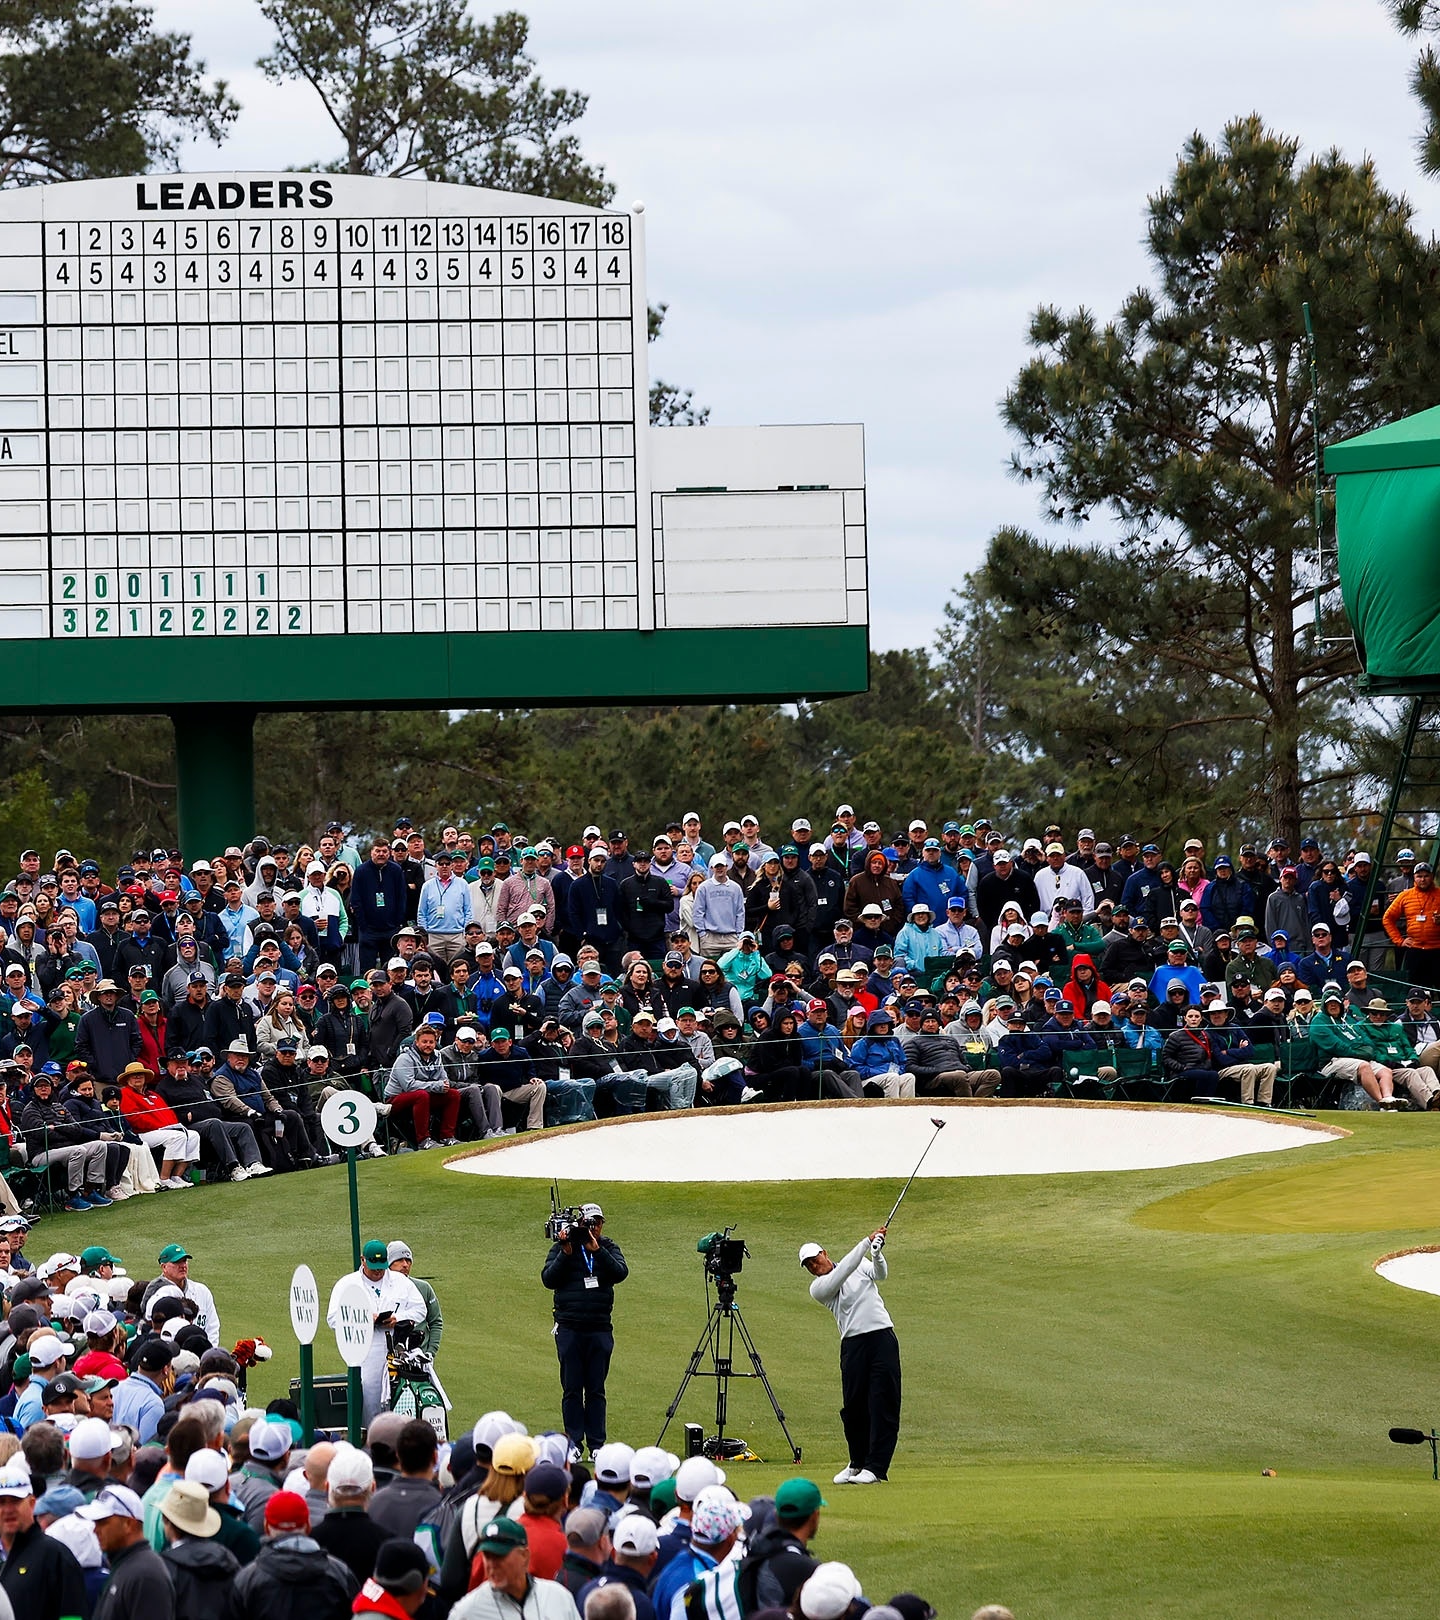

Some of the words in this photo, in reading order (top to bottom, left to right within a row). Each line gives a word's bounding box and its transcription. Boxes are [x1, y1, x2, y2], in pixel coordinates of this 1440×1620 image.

[136, 179, 334, 211] LEADERS
[57, 228, 66, 251] 1
[89, 227, 102, 250] 2
[121, 227, 134, 251] 3
[152, 227, 167, 250] 4
[184, 226, 198, 250] 5
[217, 226, 231, 249] 6
[249, 226, 262, 249] 7
[280, 225, 294, 249] 8
[314, 224, 327, 248] 9
[345, 224, 369, 248] 10
[381, 224, 398, 247] 11
[410, 223, 432, 246] 12
[442, 223, 464, 247] 13
[473, 223, 497, 246] 14
[505, 222, 529, 246] 15
[537, 222, 560, 245] 16
[569, 222, 591, 245] 17
[601, 221, 625, 245] 18
[56, 262, 70, 285] 4
[89, 262, 103, 285] 5
[120, 261, 134, 284] 4
[153, 260, 167, 284] 3
[185, 260, 199, 283] 4
[218, 260, 231, 283] 3
[249, 260, 263, 283] 4
[281, 259, 295, 283] 5
[313, 259, 328, 282] 4
[350, 258, 364, 281] 4
[382, 258, 397, 281] 4
[415, 258, 429, 281] 3
[447, 258, 460, 281] 5
[478, 257, 492, 280] 4
[511, 257, 524, 280] 5
[542, 256, 556, 280] 3
[574, 256, 588, 279] 4
[607, 256, 621, 278] 4
[64, 576, 76, 599] 2
[96, 576, 107, 598] 0
[129, 574, 140, 597] 0
[163, 575, 169, 595] 1
[195, 575, 201, 595] 1
[227, 575, 232, 595] 1
[260, 574, 264, 594] 1
[64, 610, 76, 632] 3
[96, 609, 108, 632] 2
[131, 610, 138, 631] 1
[160, 610, 172, 632] 2
[193, 608, 204, 631] 2
[225, 608, 236, 630] 2
[257, 608, 268, 629] 2
[290, 608, 300, 630] 2
[337, 1101, 359, 1135] 3
[293, 1287, 315, 1304] WALK
[196, 1314, 207, 1327] 43
[296, 1306, 313, 1323] WAY
[341, 1306, 368, 1324] WALK
[344, 1327, 366, 1344] WAY
